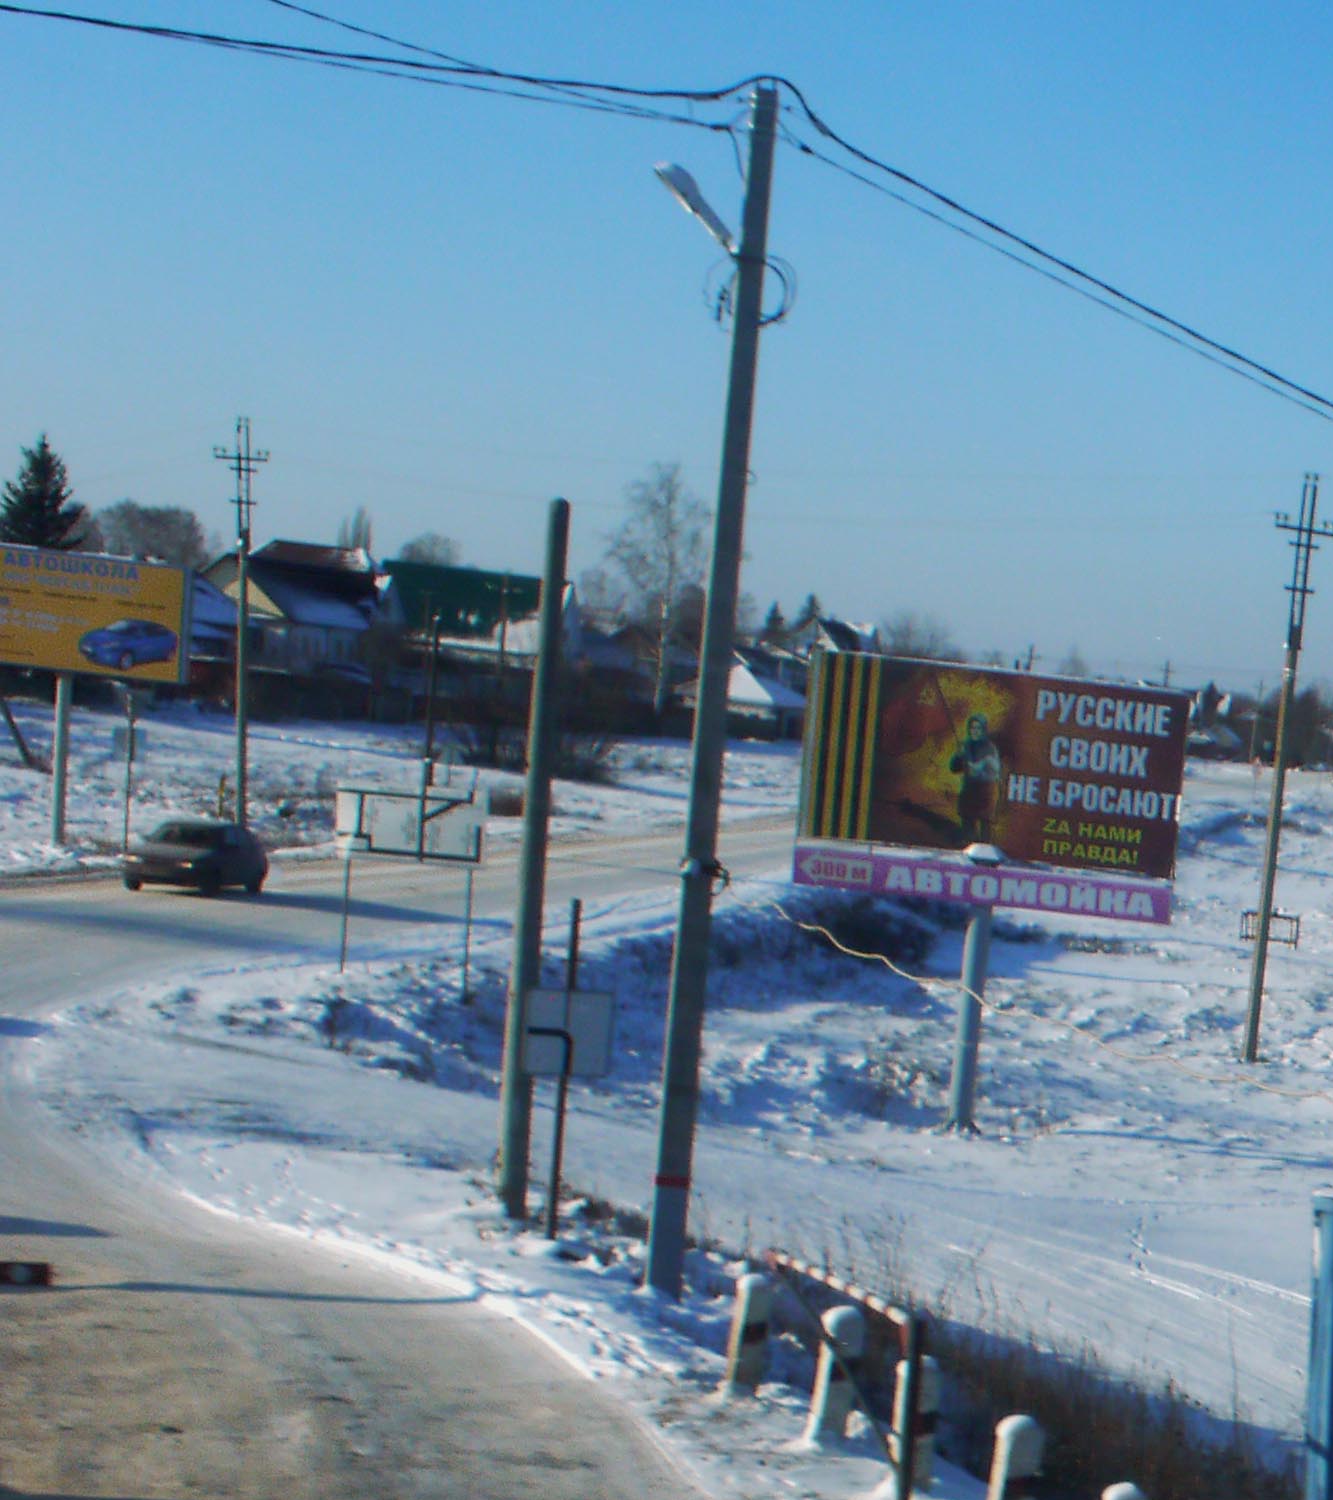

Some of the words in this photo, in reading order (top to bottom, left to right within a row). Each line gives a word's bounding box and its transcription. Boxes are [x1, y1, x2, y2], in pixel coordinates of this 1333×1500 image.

[4, 551, 139, 581] АВТОШКОЛА
[1035, 689, 1172, 737] РУССКИЕ
[1051, 736, 1149, 778] СВОИХ
[1007, 773, 1041, 804] НЕ
[1079, 822, 1142, 844] НАМИ
[1043, 840, 1139, 865] ПРАВДА!
[811, 859, 847, 877] 300
[885, 865, 1155, 918] АВТОМОЙКА
